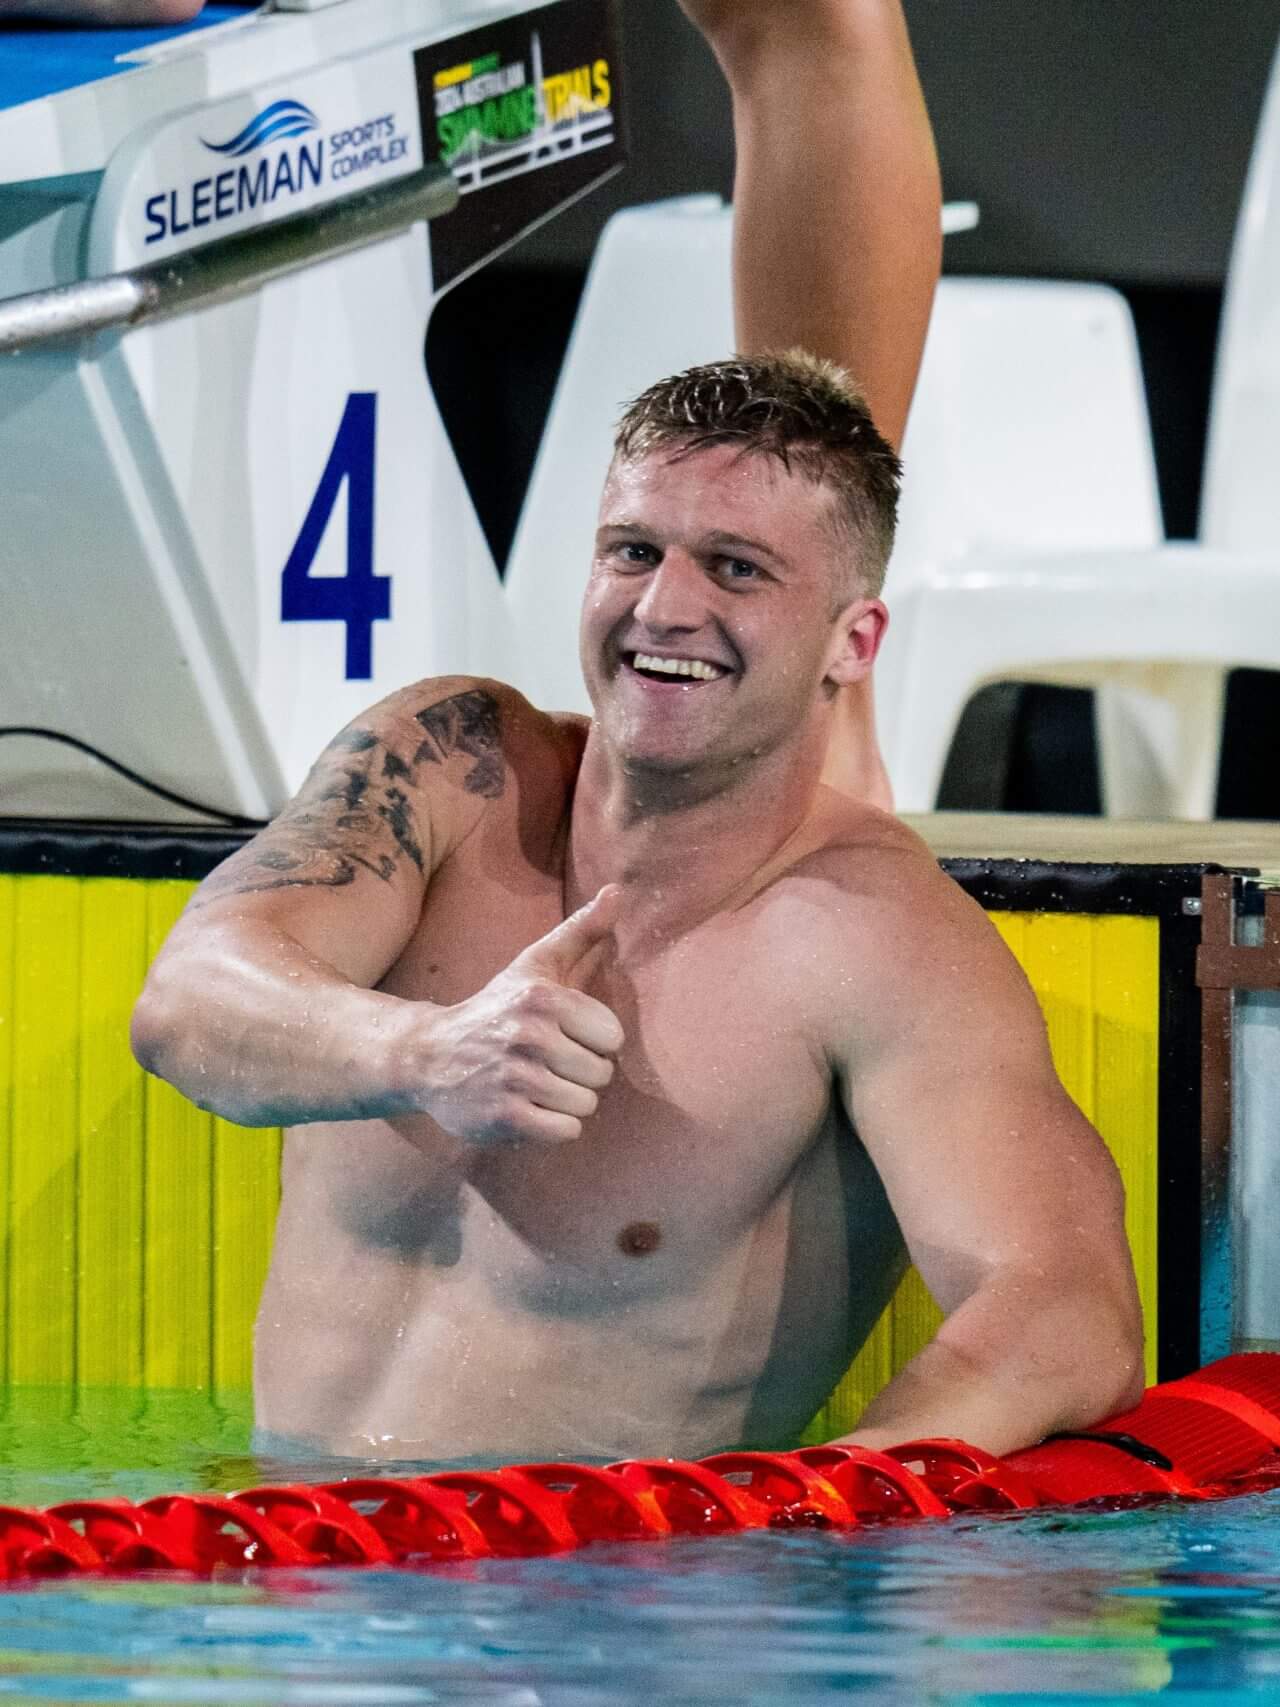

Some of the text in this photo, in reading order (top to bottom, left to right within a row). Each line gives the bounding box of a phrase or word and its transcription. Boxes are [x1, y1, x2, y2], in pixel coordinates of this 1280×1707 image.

[543, 59, 611, 122] TRIALS
[329, 113, 395, 156] SPORTS
[332, 137, 408, 180] COMPLEX
[145, 139, 323, 244] SLEEMAN
[281, 391, 392, 680] 4
